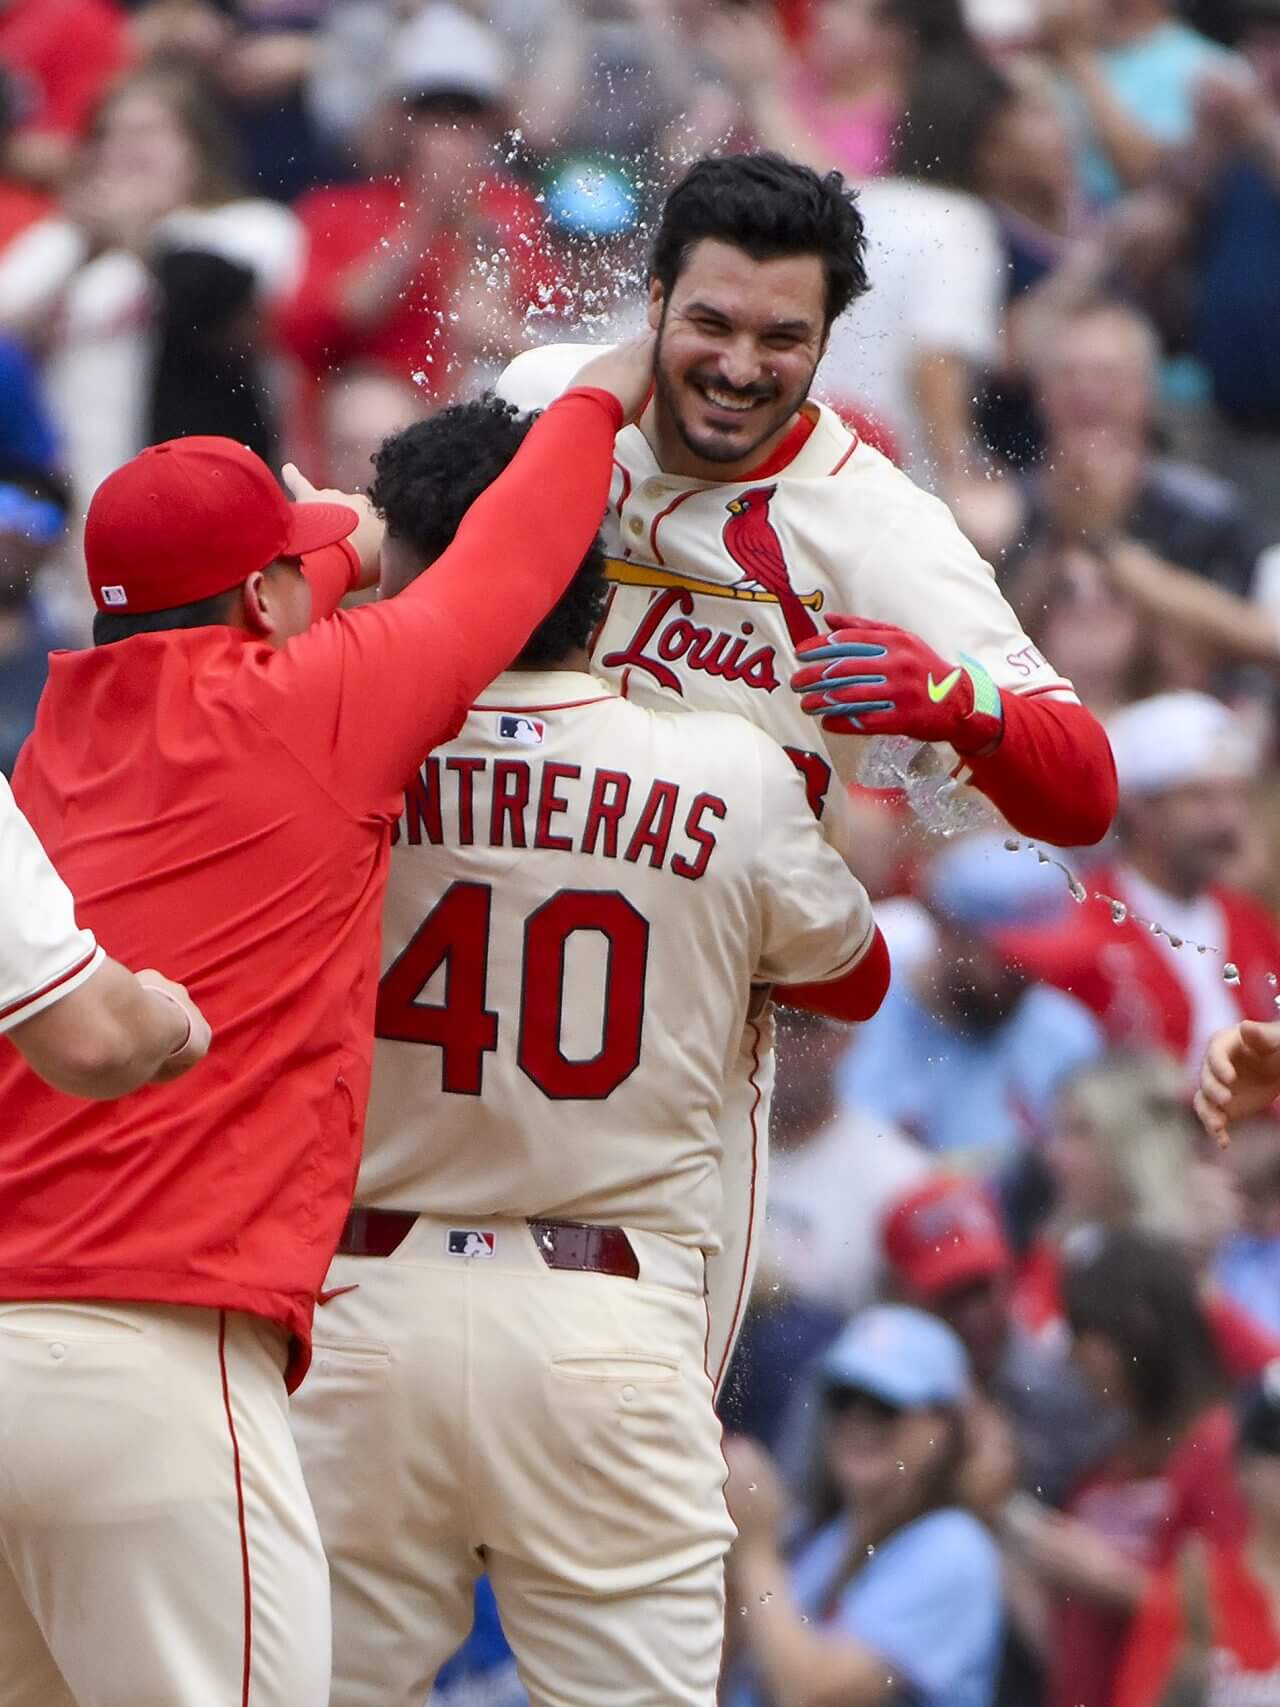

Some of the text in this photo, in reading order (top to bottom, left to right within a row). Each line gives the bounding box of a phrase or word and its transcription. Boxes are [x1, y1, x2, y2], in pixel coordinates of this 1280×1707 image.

[601, 585, 782, 699] Louis
[389, 756, 728, 881] NTRERAS
[375, 880, 650, 1100] 40
